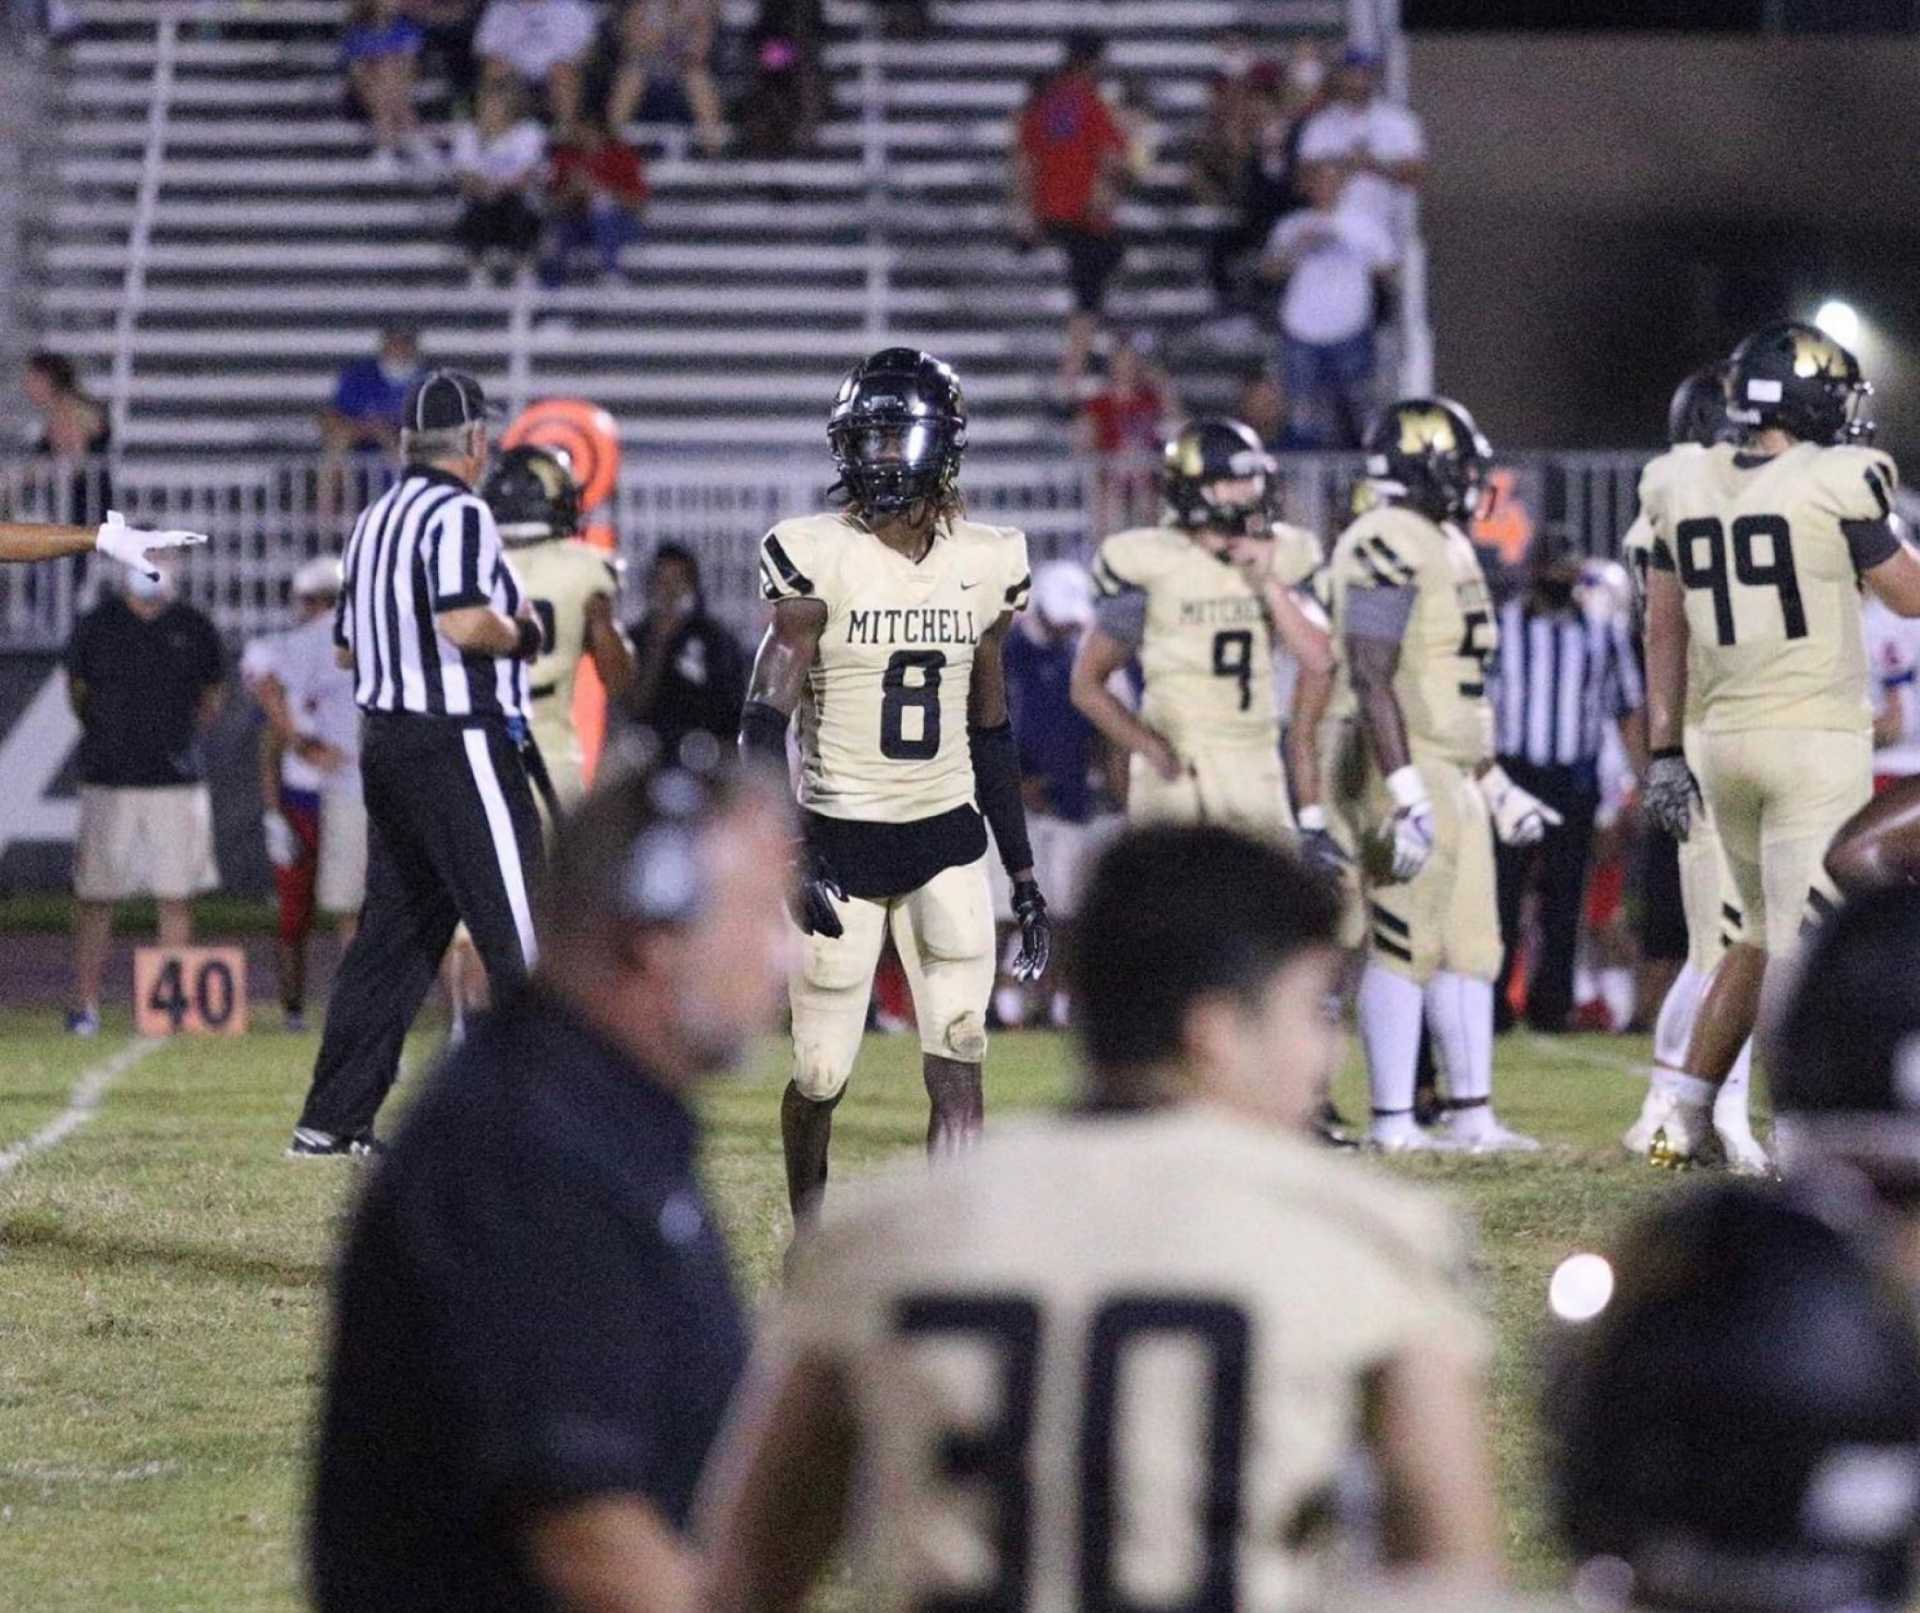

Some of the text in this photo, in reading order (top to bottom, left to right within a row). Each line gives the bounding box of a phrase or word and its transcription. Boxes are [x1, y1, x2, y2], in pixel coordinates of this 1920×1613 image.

[1179, 597, 1262, 624] MITCH
[1677, 513, 1808, 646] 99
[846, 608, 978, 644] MITCHELL
[879, 649, 947, 760] 8
[1213, 629, 1252, 712] 9
[148, 958, 234, 1027] 40
[892, 1290, 1250, 1613] 30
